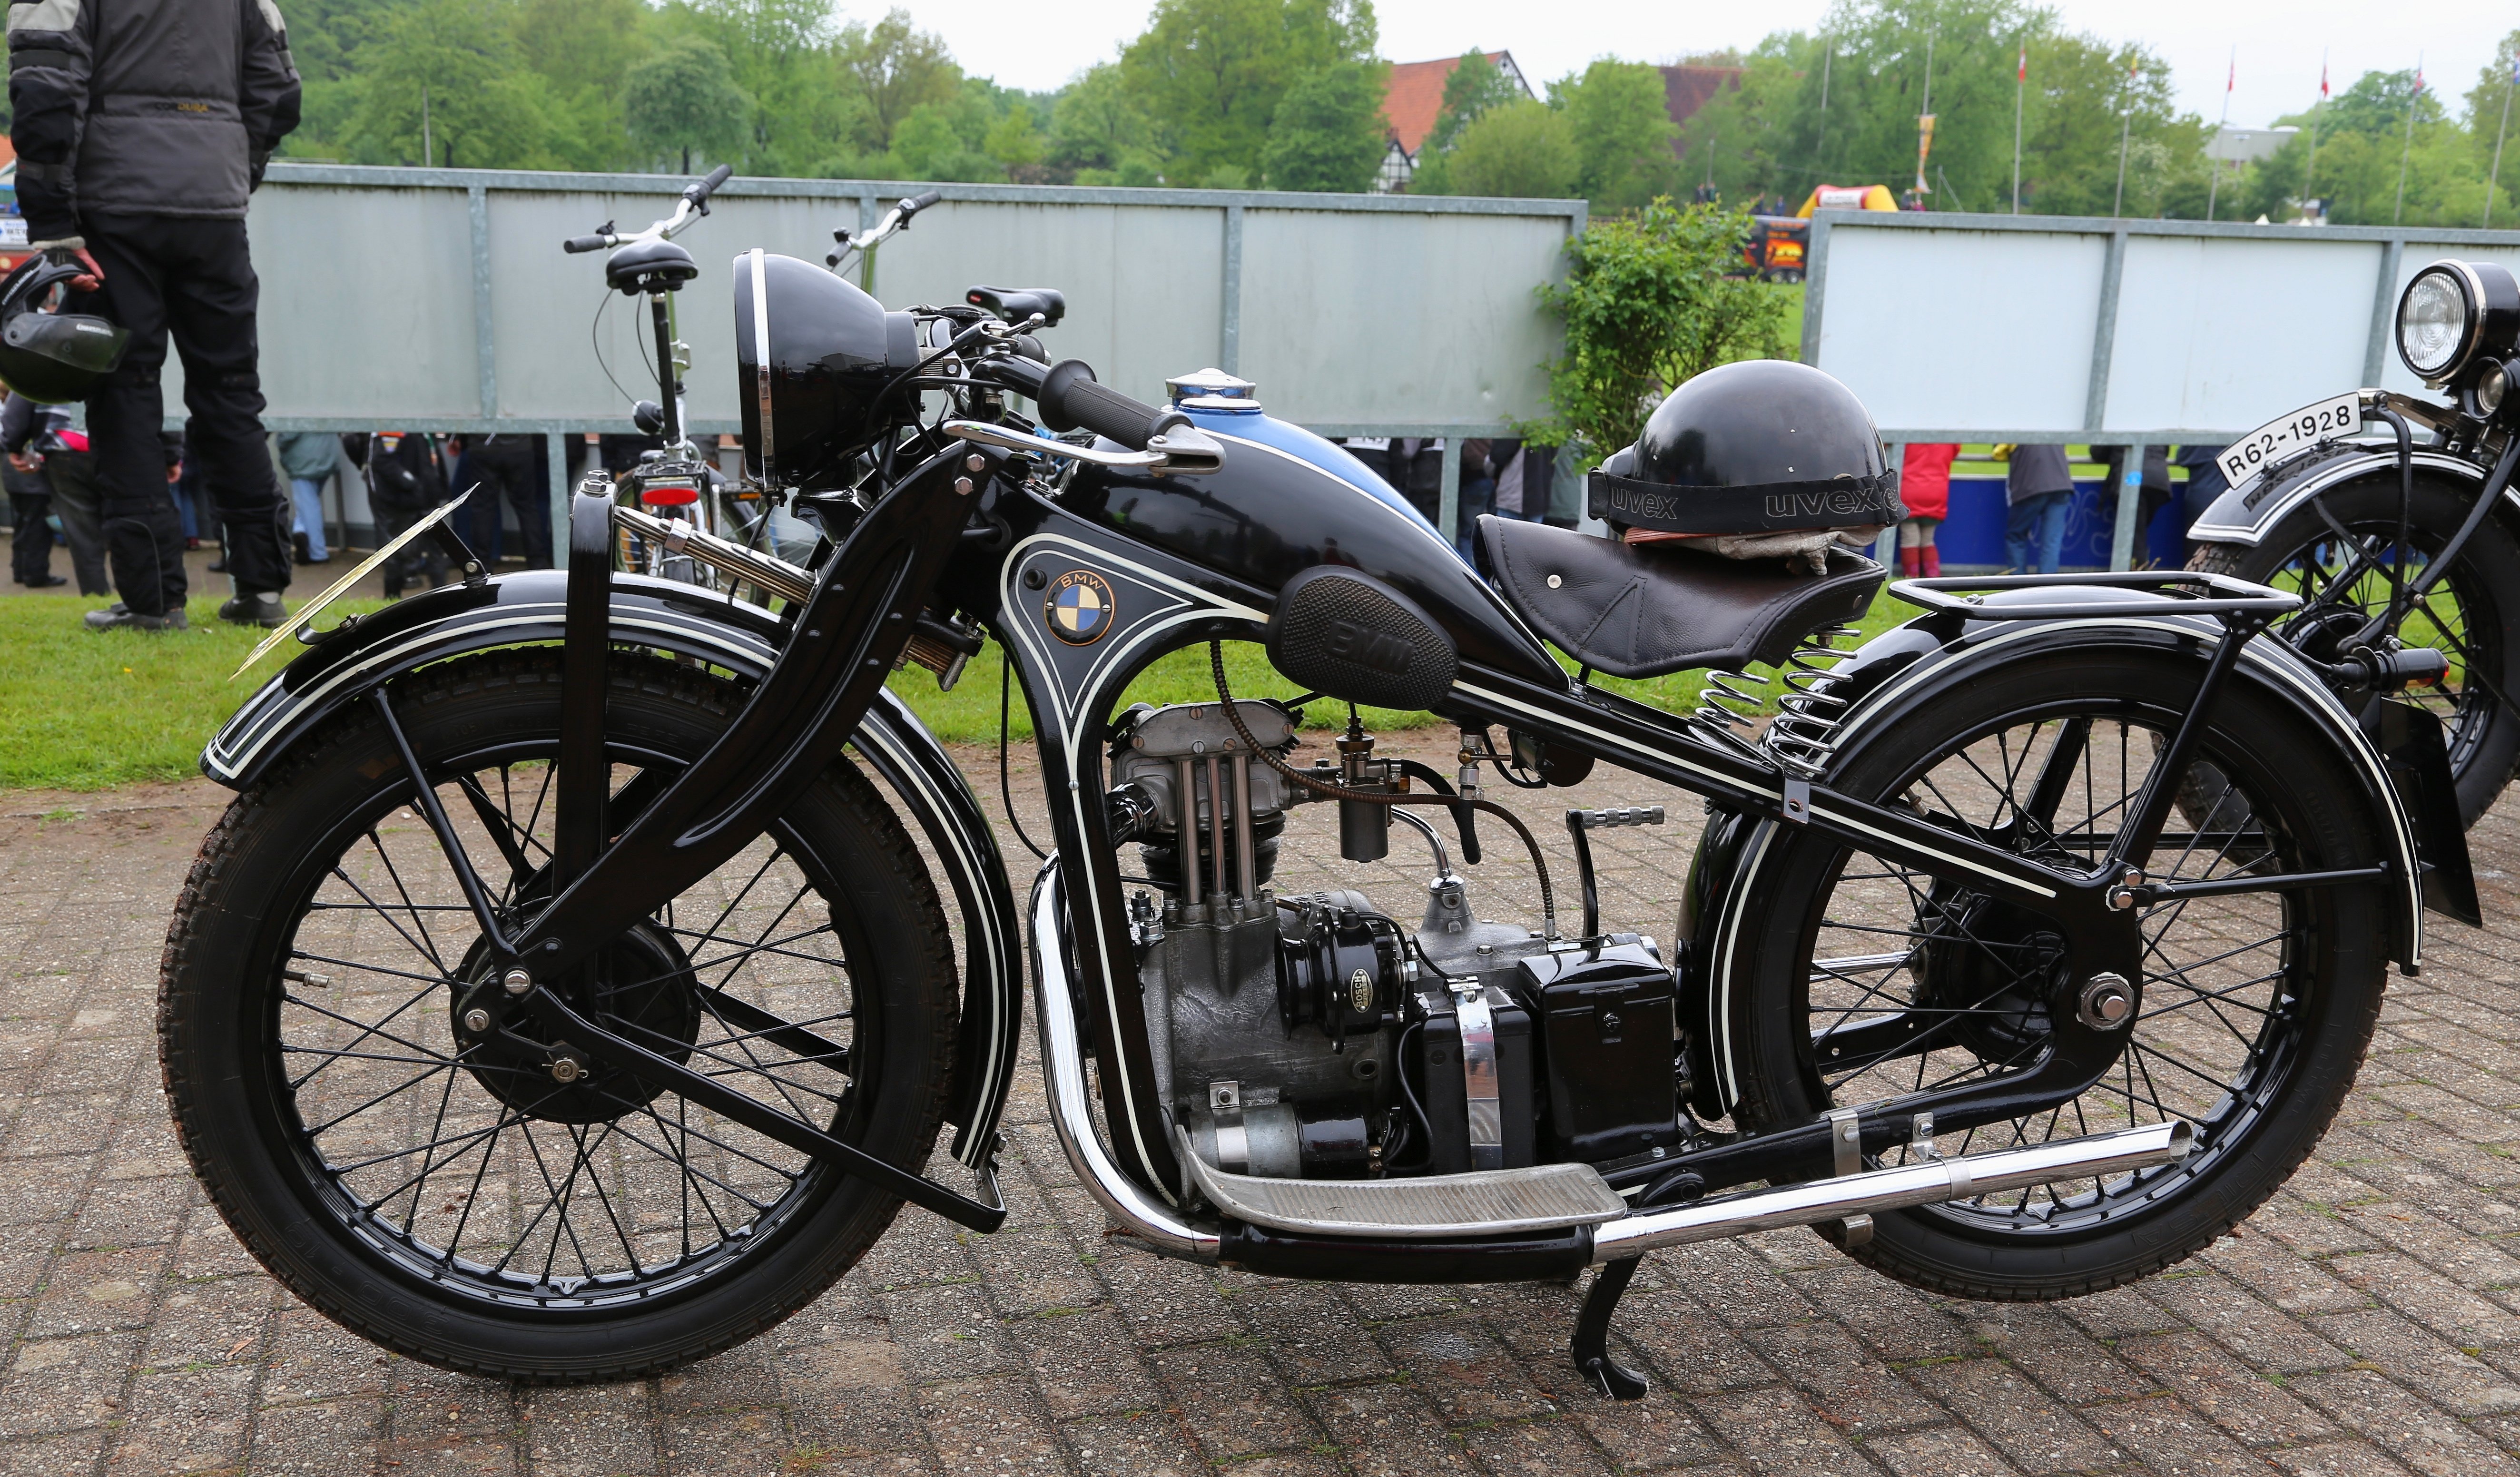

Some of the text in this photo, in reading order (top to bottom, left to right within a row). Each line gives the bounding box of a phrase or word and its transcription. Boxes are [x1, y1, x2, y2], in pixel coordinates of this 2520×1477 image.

[2227, 405, 2350, 476] R62-1928
[1611, 486, 1678, 520] uvex
[1766, 487, 1881, 517] uvex
[1061, 573, 1103, 590] BMW
[1331, 621, 1413, 669] BMW
[1354, 976, 1363, 1007] BOSCH
